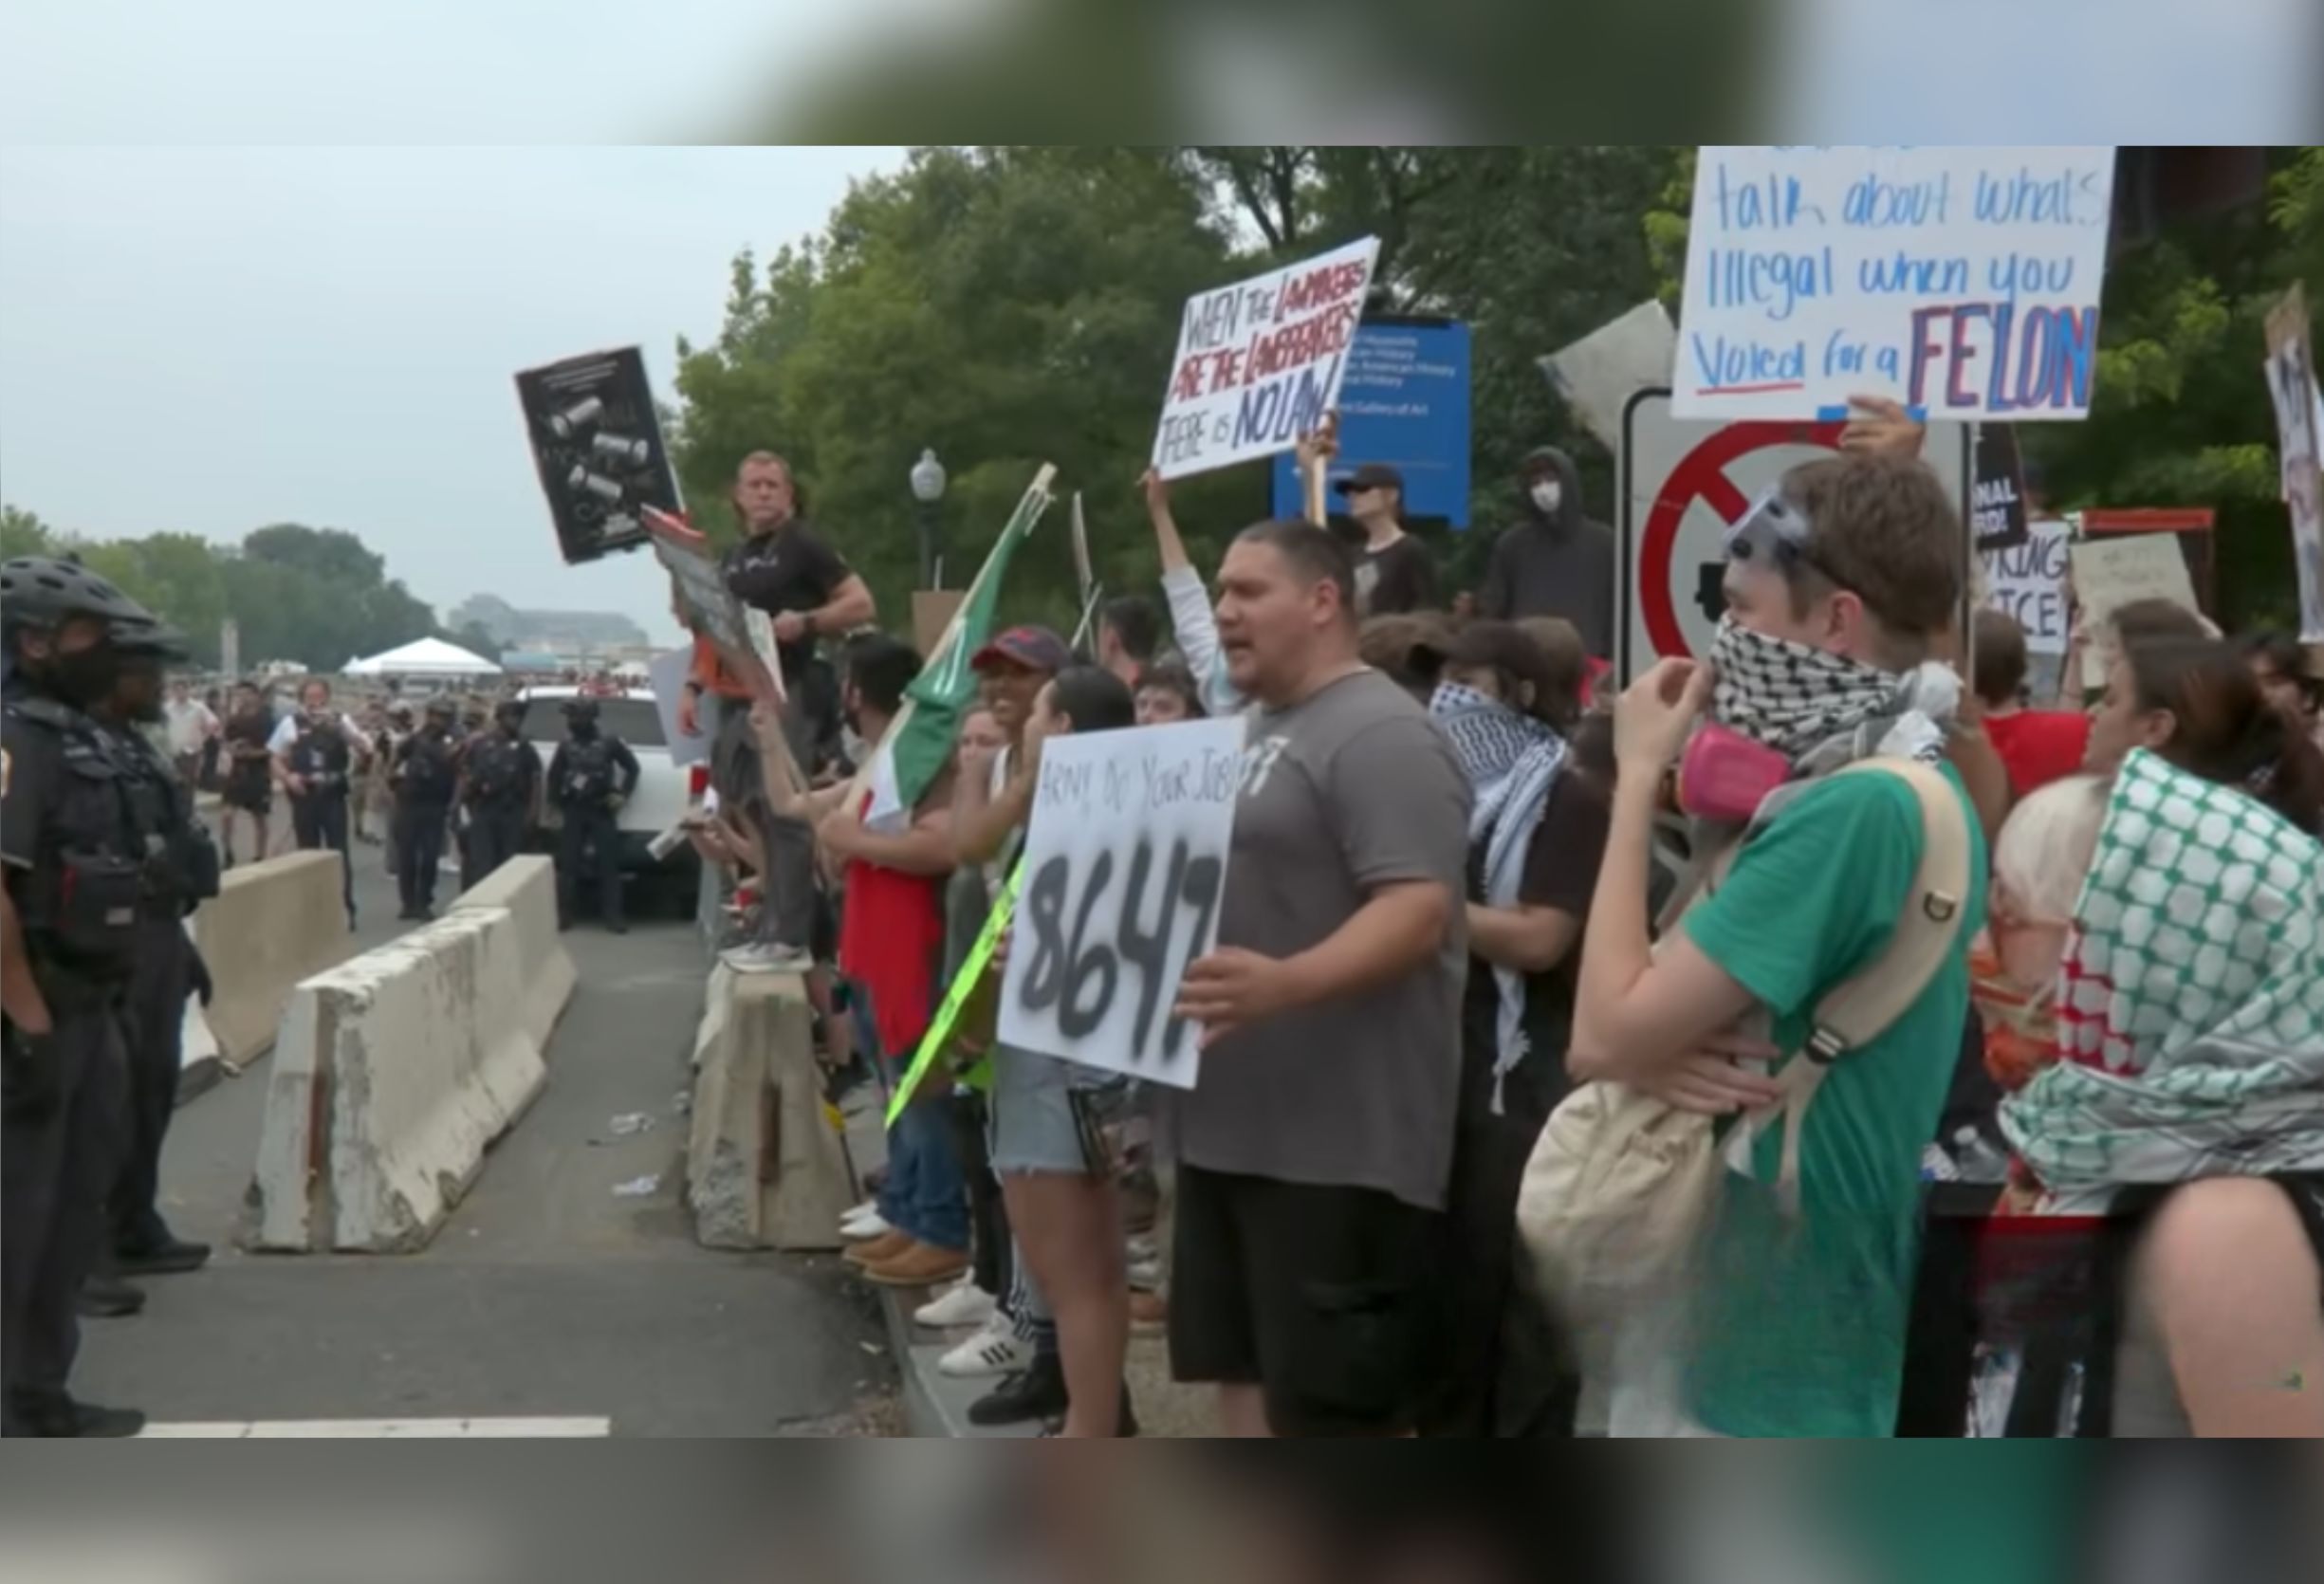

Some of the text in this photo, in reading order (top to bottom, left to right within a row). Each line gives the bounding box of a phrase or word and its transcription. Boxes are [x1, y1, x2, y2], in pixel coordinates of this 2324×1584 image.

[1713, 162, 1827, 230] talk
[1843, 170, 1950, 230] about
[1858, 249, 1969, 295] when
[1988, 251, 2075, 304] you
[1692, 301, 2099, 414] Voted for a FELON
[1232, 381, 1282, 451] NO
[1983, 534, 2068, 580] KING
